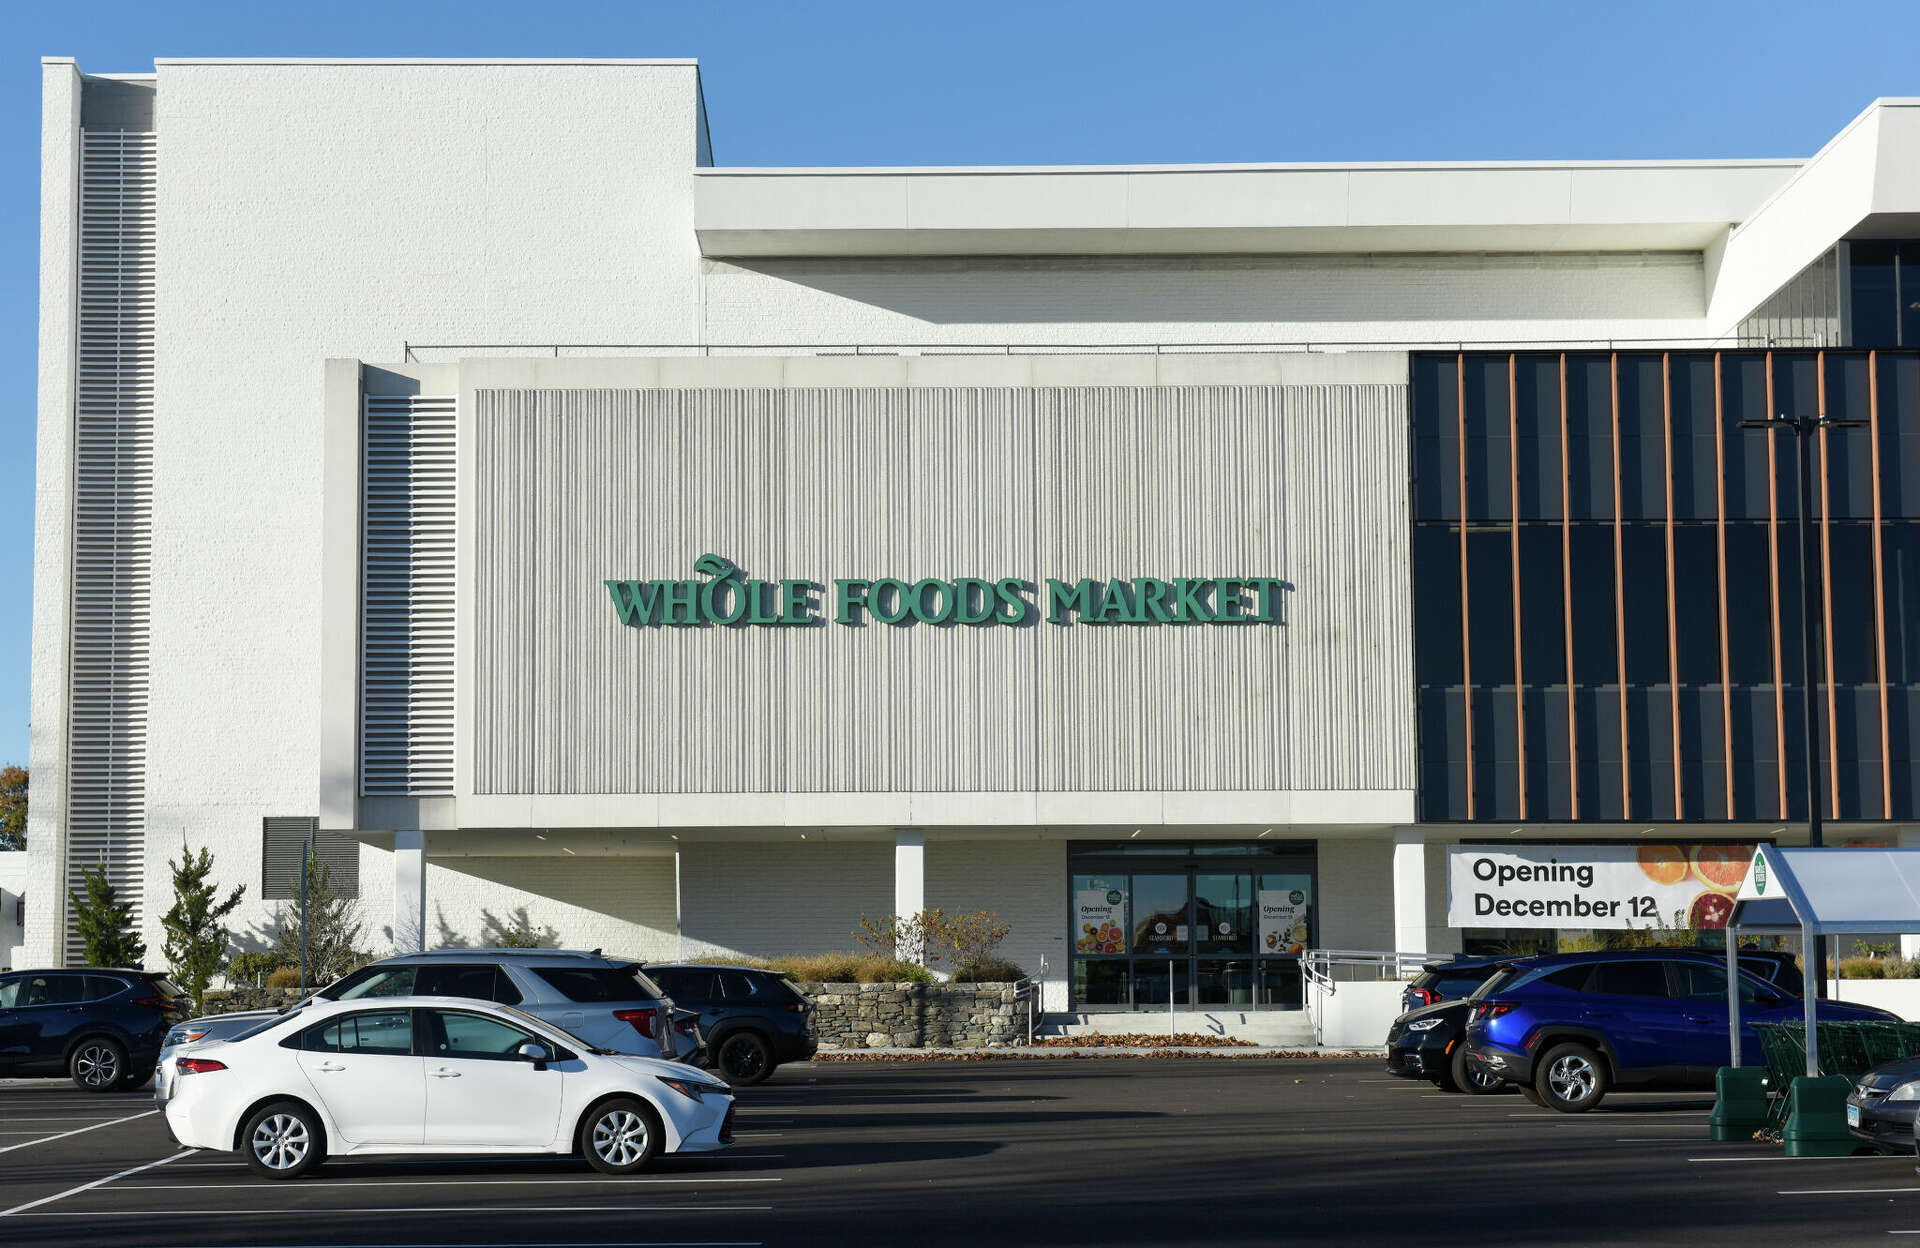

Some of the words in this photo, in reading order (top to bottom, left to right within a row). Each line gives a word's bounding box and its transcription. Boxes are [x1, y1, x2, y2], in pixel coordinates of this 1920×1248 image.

[604, 553, 813, 624] WHOLE
[834, 577, 1025, 624] FOODS
[1045, 577, 1282, 622] MARKET
[1473, 858, 1594, 888] Opening
[1081, 905, 1112, 914] Opening
[1474, 893, 1620, 917] December
[1627, 896, 1656, 917] 12
